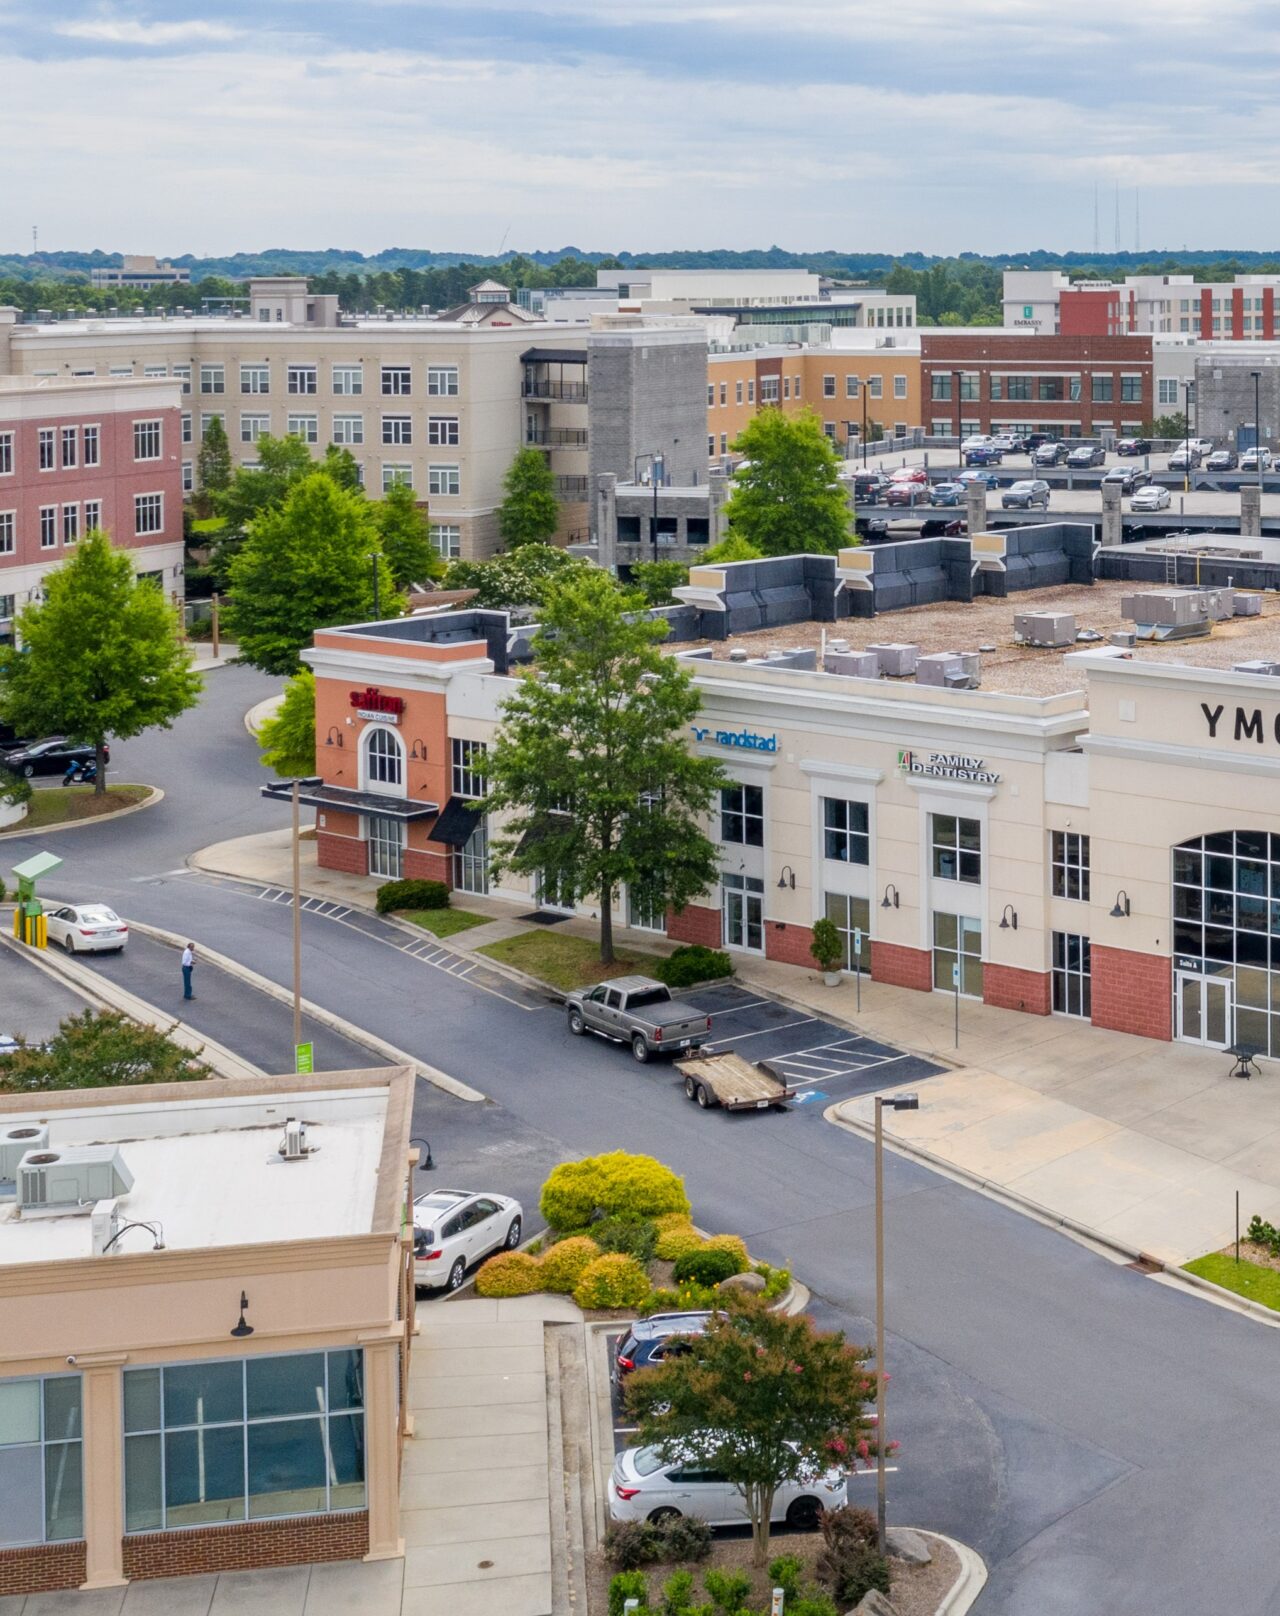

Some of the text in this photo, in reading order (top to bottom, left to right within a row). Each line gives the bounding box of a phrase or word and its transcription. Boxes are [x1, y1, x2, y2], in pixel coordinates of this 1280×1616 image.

[716, 729, 776, 752] randstad
[928, 753, 983, 769] FAMILY
[912, 763, 1000, 783] DENTISTRY
